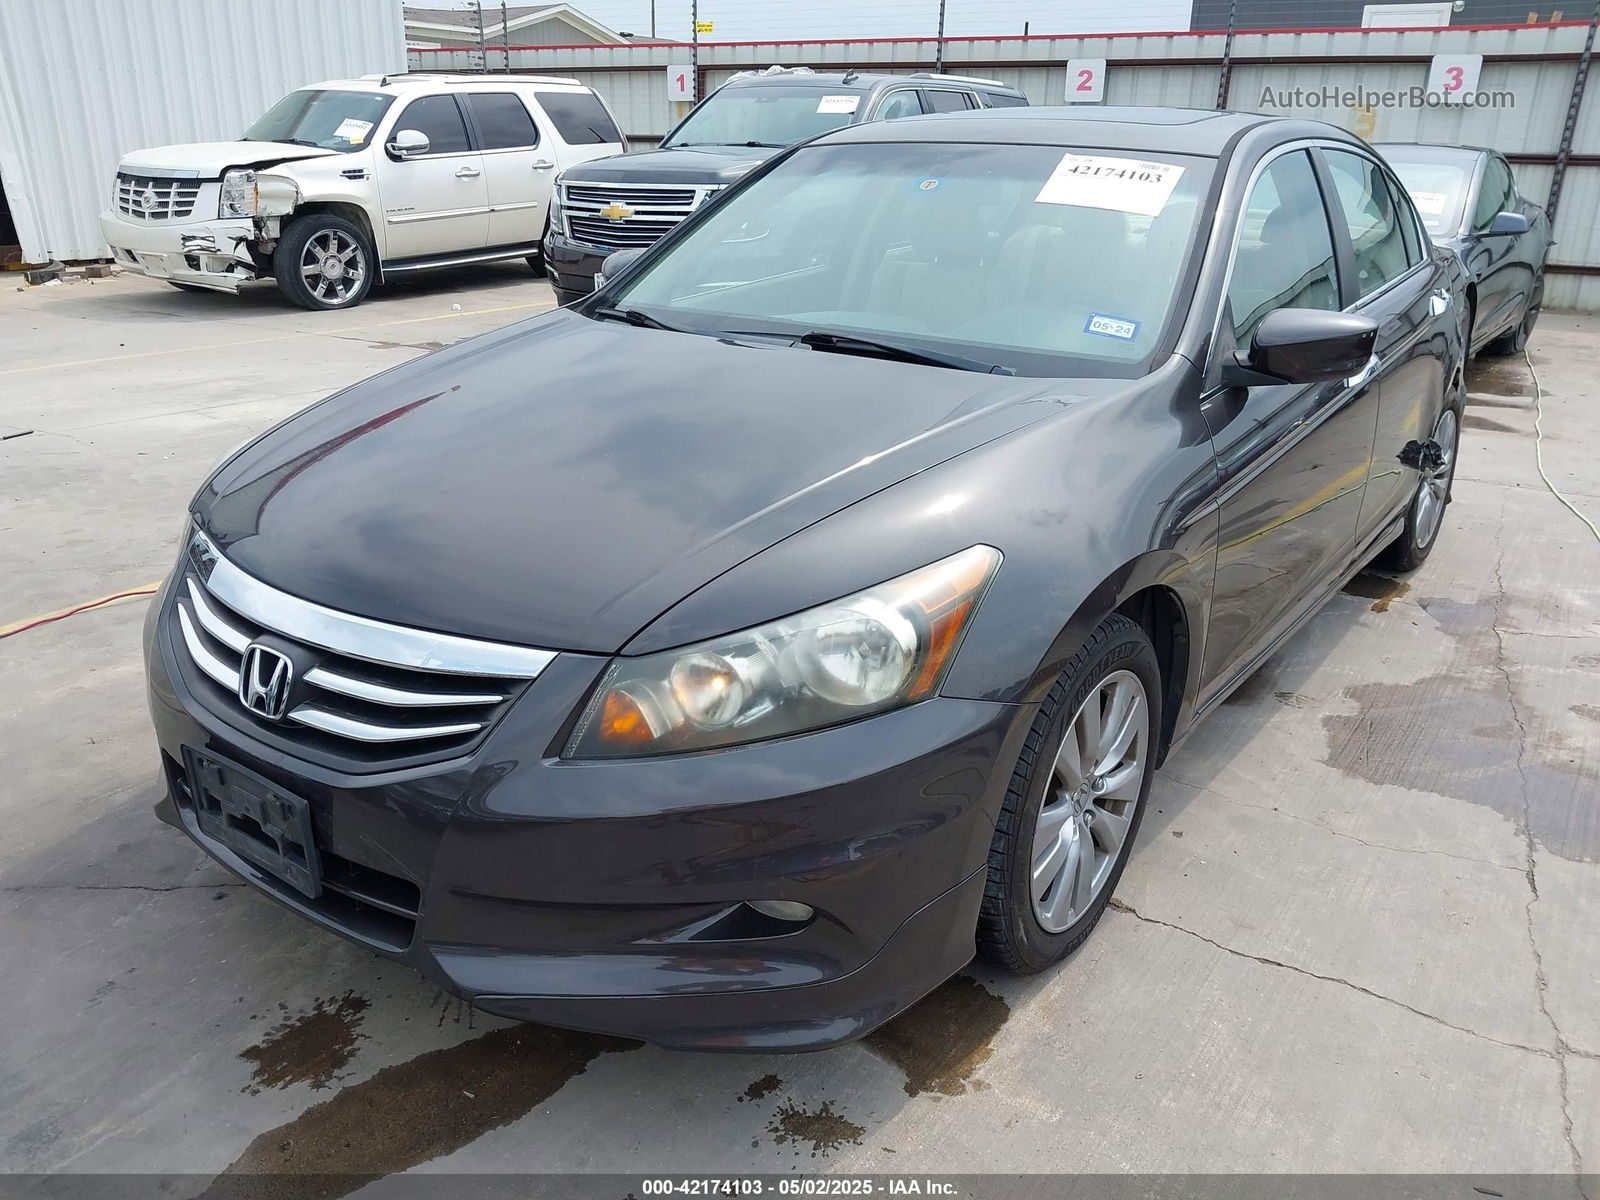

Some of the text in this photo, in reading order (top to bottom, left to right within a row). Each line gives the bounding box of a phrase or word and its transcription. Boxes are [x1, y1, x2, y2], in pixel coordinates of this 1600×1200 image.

[676, 73, 685, 92] 1
[1076, 69, 1093, 91] 2
[1442, 66, 1464, 91] 3
[1067, 165, 1163, 183] 42174103
